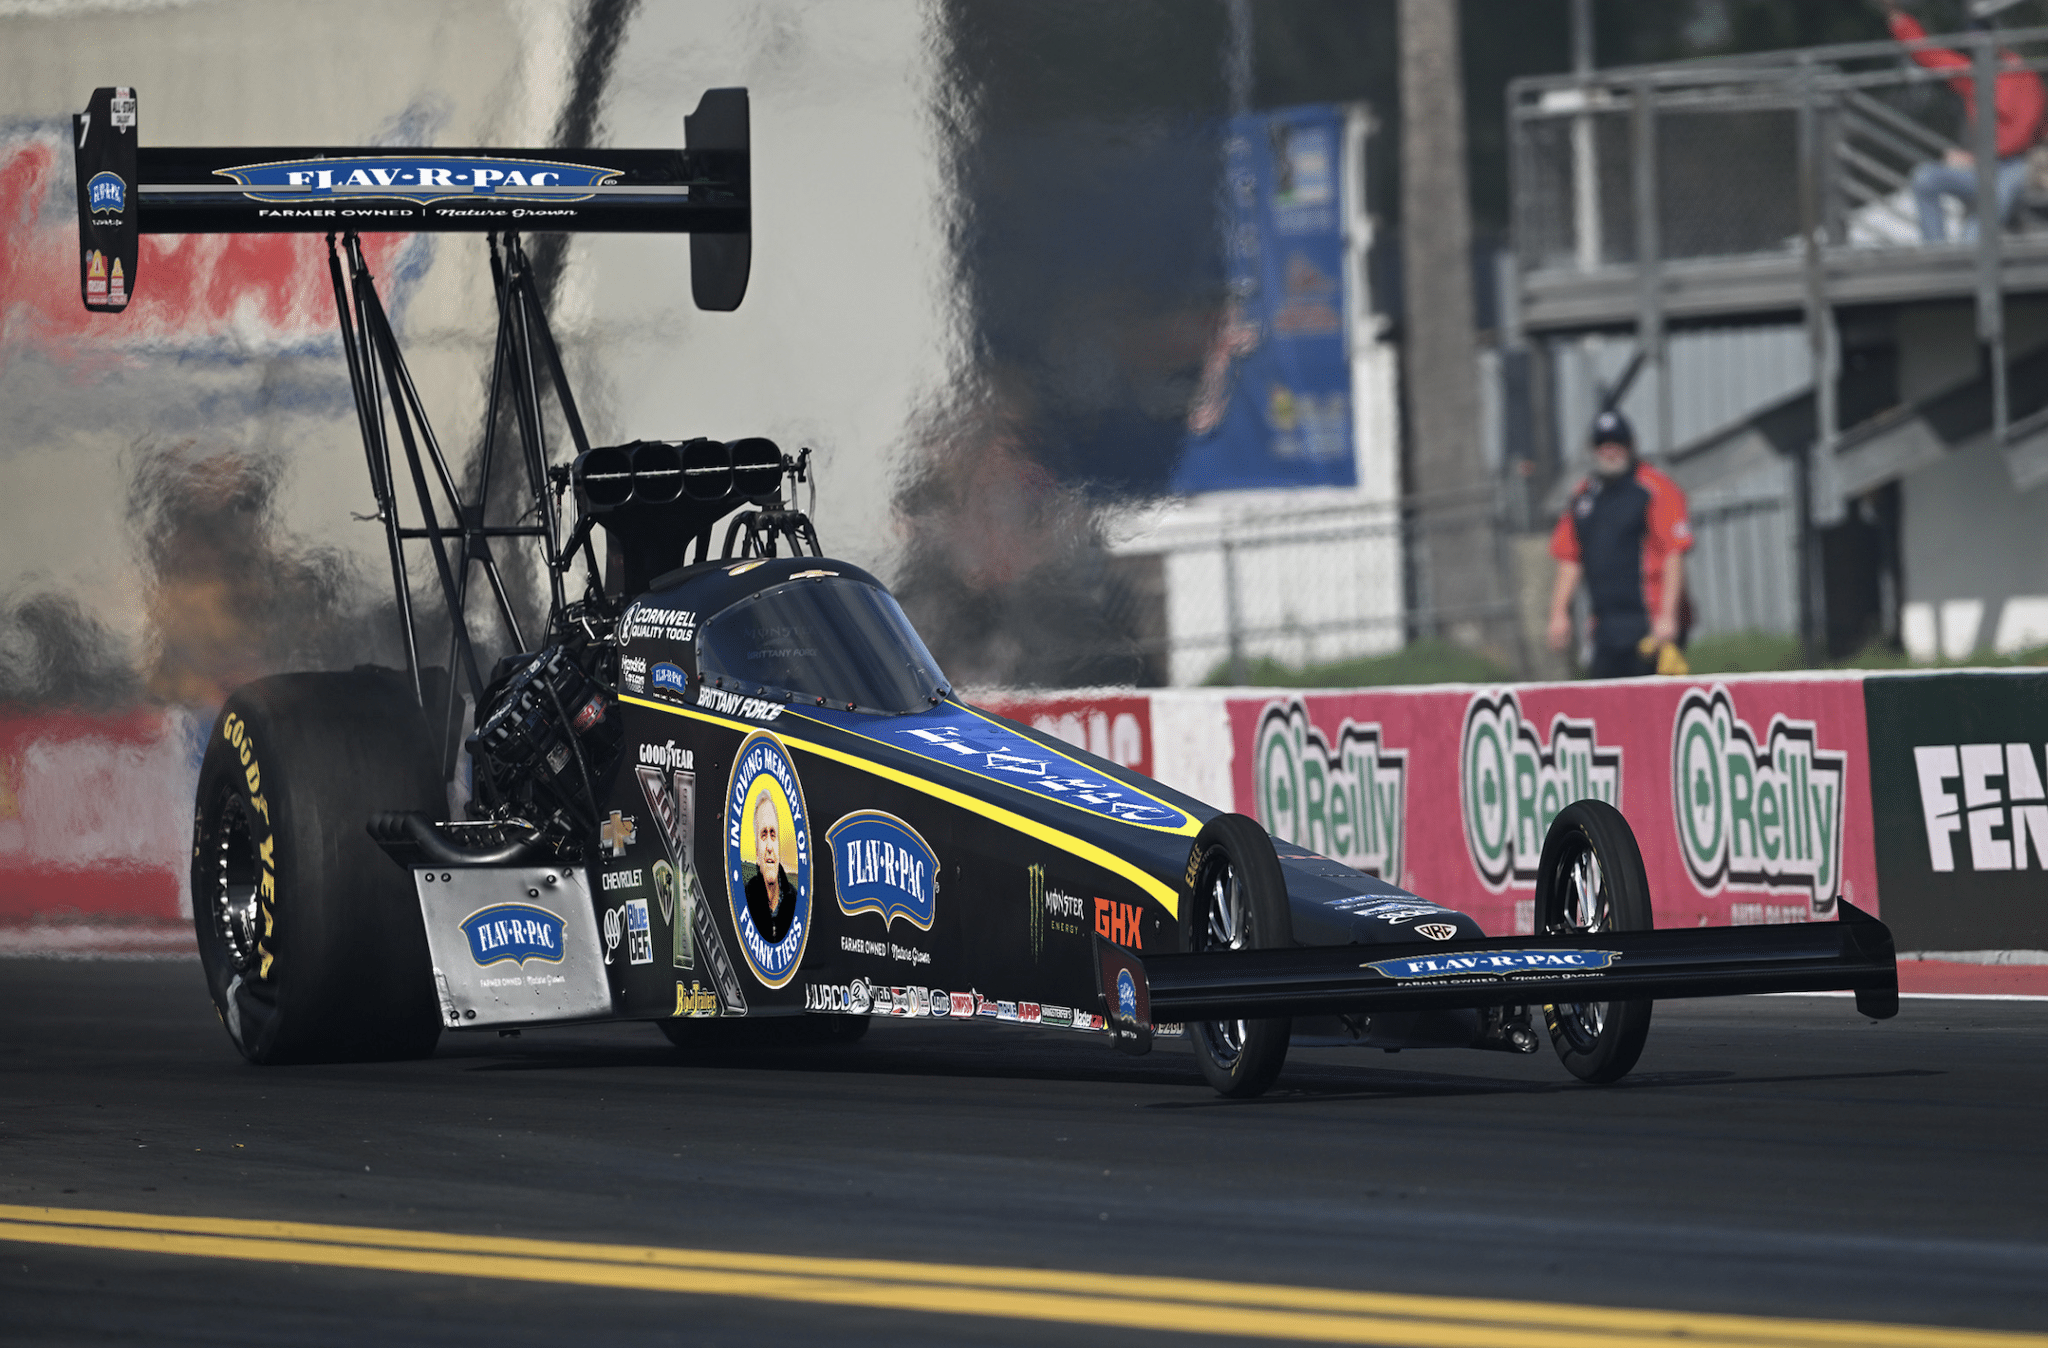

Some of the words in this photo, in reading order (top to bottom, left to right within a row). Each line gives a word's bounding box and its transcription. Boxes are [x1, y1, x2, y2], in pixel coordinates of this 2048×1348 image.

[79, 112, 91, 150] 7
[259, 209, 336, 217] FARMER
[341, 209, 413, 217] OWNED
[436, 208, 508, 217] Nature
[511, 208, 578, 218] Grown
[635, 607, 696, 628] CORNWELL
[632, 625, 662, 639] QUALITY
[666, 627, 693, 641] TOOLS
[696, 685, 744, 719] BRITTANY
[740, 698, 786, 721] FORCE
[639, 742, 694, 770] GOODYEAR
[732, 748, 763, 814] LOVING
[764, 747, 802, 820] MEMORY
[1680, 715, 1834, 889] O'Reilly
[730, 821, 740, 848] IN
[797, 829, 808, 865] OF
[602, 869, 643, 891] CHEVROLET
[627, 903, 648, 930] Blue
[1045, 888, 1085, 920] MONSTER
[740, 906, 774, 970] FRANK
[775, 895, 803, 970] TIEGS
[1051, 920, 1079, 936] ENERGY
[1093, 896, 1144, 950] GHX
[630, 930, 651, 961] DEF
[841, 935, 865, 954] FARMER
[865, 940, 886, 957] OWNED
[805, 983, 850, 1011] HURCO
[1397, 979, 1449, 987] FARMER
[1018, 1002, 1041, 1020] ARP
